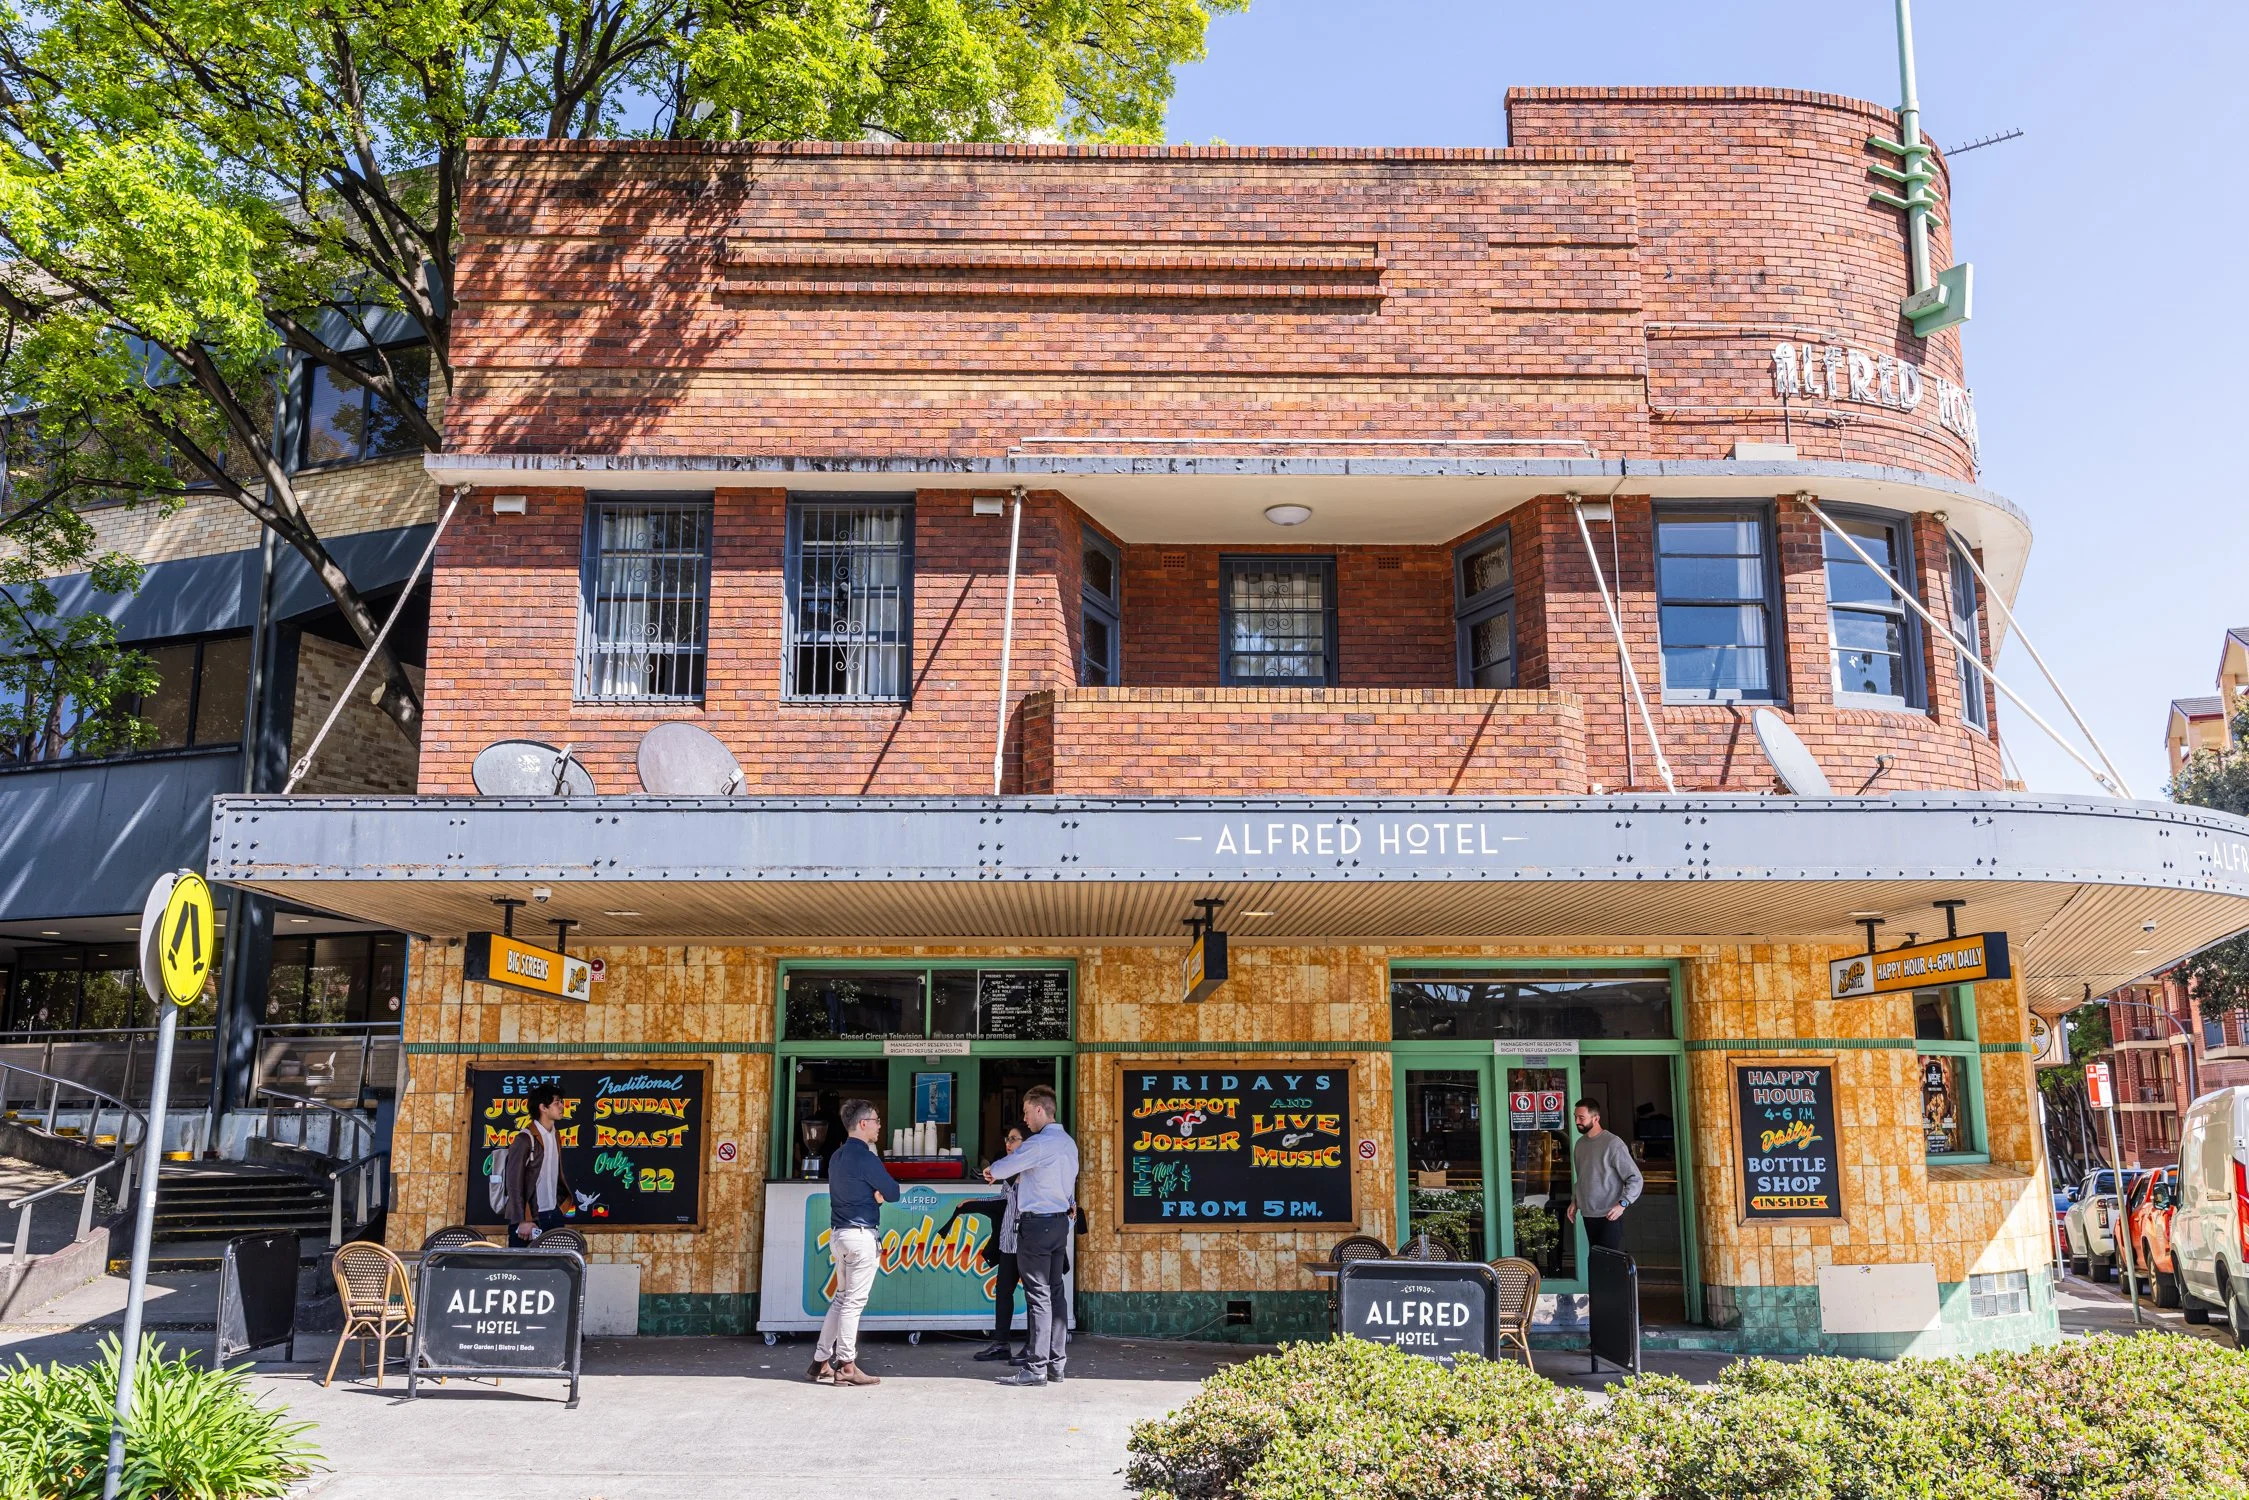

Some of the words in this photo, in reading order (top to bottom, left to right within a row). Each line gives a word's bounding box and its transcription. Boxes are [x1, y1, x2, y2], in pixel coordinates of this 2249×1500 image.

[1771, 342, 1923, 410] ALFRED
[1216, 824, 1361, 854] ALFRED
[1379, 823, 1498, 854] HOTEL
[507, 949, 519, 974] BIG
[521, 953, 549, 981] SCREENS
[1876, 960, 1902, 981] HAPPY
[1904, 957, 1926, 977] HOUR
[1927, 952, 1955, 973] 4-6PM
[1958, 947, 1982, 969] DAILY
[591, 973, 605, 981] FIRE
[503, 1076, 561, 1085] CRAFT
[596, 1075, 684, 1098] Traditional
[1142, 1075, 1331, 1091] FRIDAYS
[1748, 1071, 1820, 1085] HAPPY
[1270, 1098, 1313, 1109] AND
[1753, 1088, 1817, 1104] HOUR
[594, 1097, 691, 1120] SUNDAY
[1132, 1098, 1240, 1119] JACKPOT
[1764, 1108, 1793, 1120] 4-6
[1799, 1108, 1815, 1120] P.M.
[1251, 1114, 1340, 1138] LIVE
[594, 1124, 690, 1148] ROAST
[1133, 1130, 1241, 1152] JOKER
[1760, 1120, 1823, 1153] Daily
[595, 1151, 629, 1177] Only
[1250, 1145, 1342, 1168] MUSIC
[1748, 1157, 1827, 1173] BOTTLE
[1180, 1164, 1191, 1192] $
[1757, 1176, 1821, 1192] SHOP
[901, 1196, 937, 1205] ALFRED
[1161, 1200, 1248, 1217] FROM
[1263, 1200, 1286, 1217] 5
[1290, 1202, 1324, 1217] P.M.
[1759, 1198, 1820, 1207] INSIDE
[488, 1273, 500, 1281] EST
[501, 1273, 517, 1281] 1939
[1404, 1285, 1415, 1293] EST
[1416, 1285, 1432, 1293] 1939
[447, 1289, 555, 1314] ALFRED
[1365, 1300, 1470, 1327] ALFRED
[476, 1321, 521, 1334] HOTEL
[1396, 1332, 1438, 1346] HOTEL
